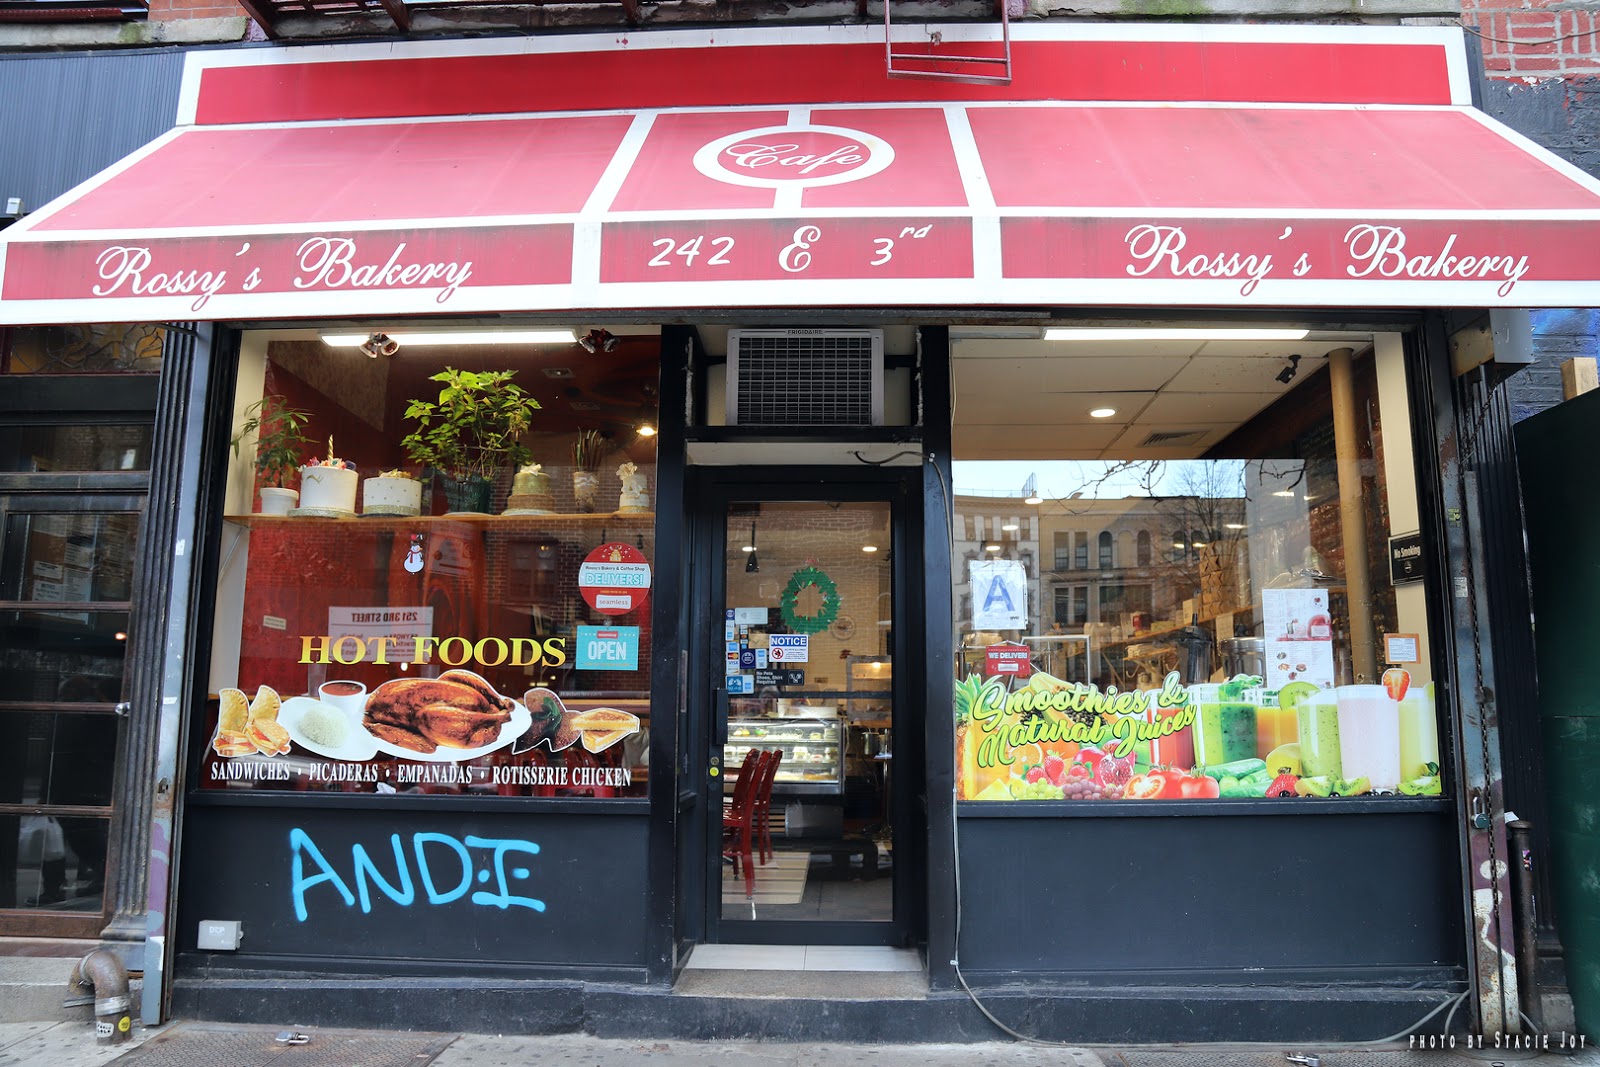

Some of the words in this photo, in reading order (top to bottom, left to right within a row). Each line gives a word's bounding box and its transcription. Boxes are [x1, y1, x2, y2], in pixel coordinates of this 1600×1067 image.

[726, 143, 864, 175] Cafe
[648, 235, 735, 267] 242
[778, 225, 822, 273] E
[1123, 224, 1312, 297] Rossy's
[1343, 224, 1530, 298] Bakery
[92, 242, 262, 312] Rossy's
[294, 237, 473, 303] Bakery
[1393, 548, 1400, 558] No
[1400, 545, 1421, 558] Smoking
[585, 572, 644, 586] DELIVERS!
[982, 574, 1016, 612] A
[297, 635, 398, 666] HOT
[411, 636, 567, 668] FOODS
[587, 640, 627, 661] OPEN
[771, 636, 807, 646] NOTICE
[973, 681, 1150, 732] Smoothies
[1155, 671, 1189, 707] &
[977, 714, 1107, 768] Natural
[1113, 704, 1198, 759] Juices
[210, 761, 291, 781] SANDWICHES
[308, 762, 379, 783] PICADERAS
[397, 763, 474, 785] EMPANADAS
[492, 765, 569, 787] ROTISSERIE
[572, 766, 632, 787] CHICKEN
